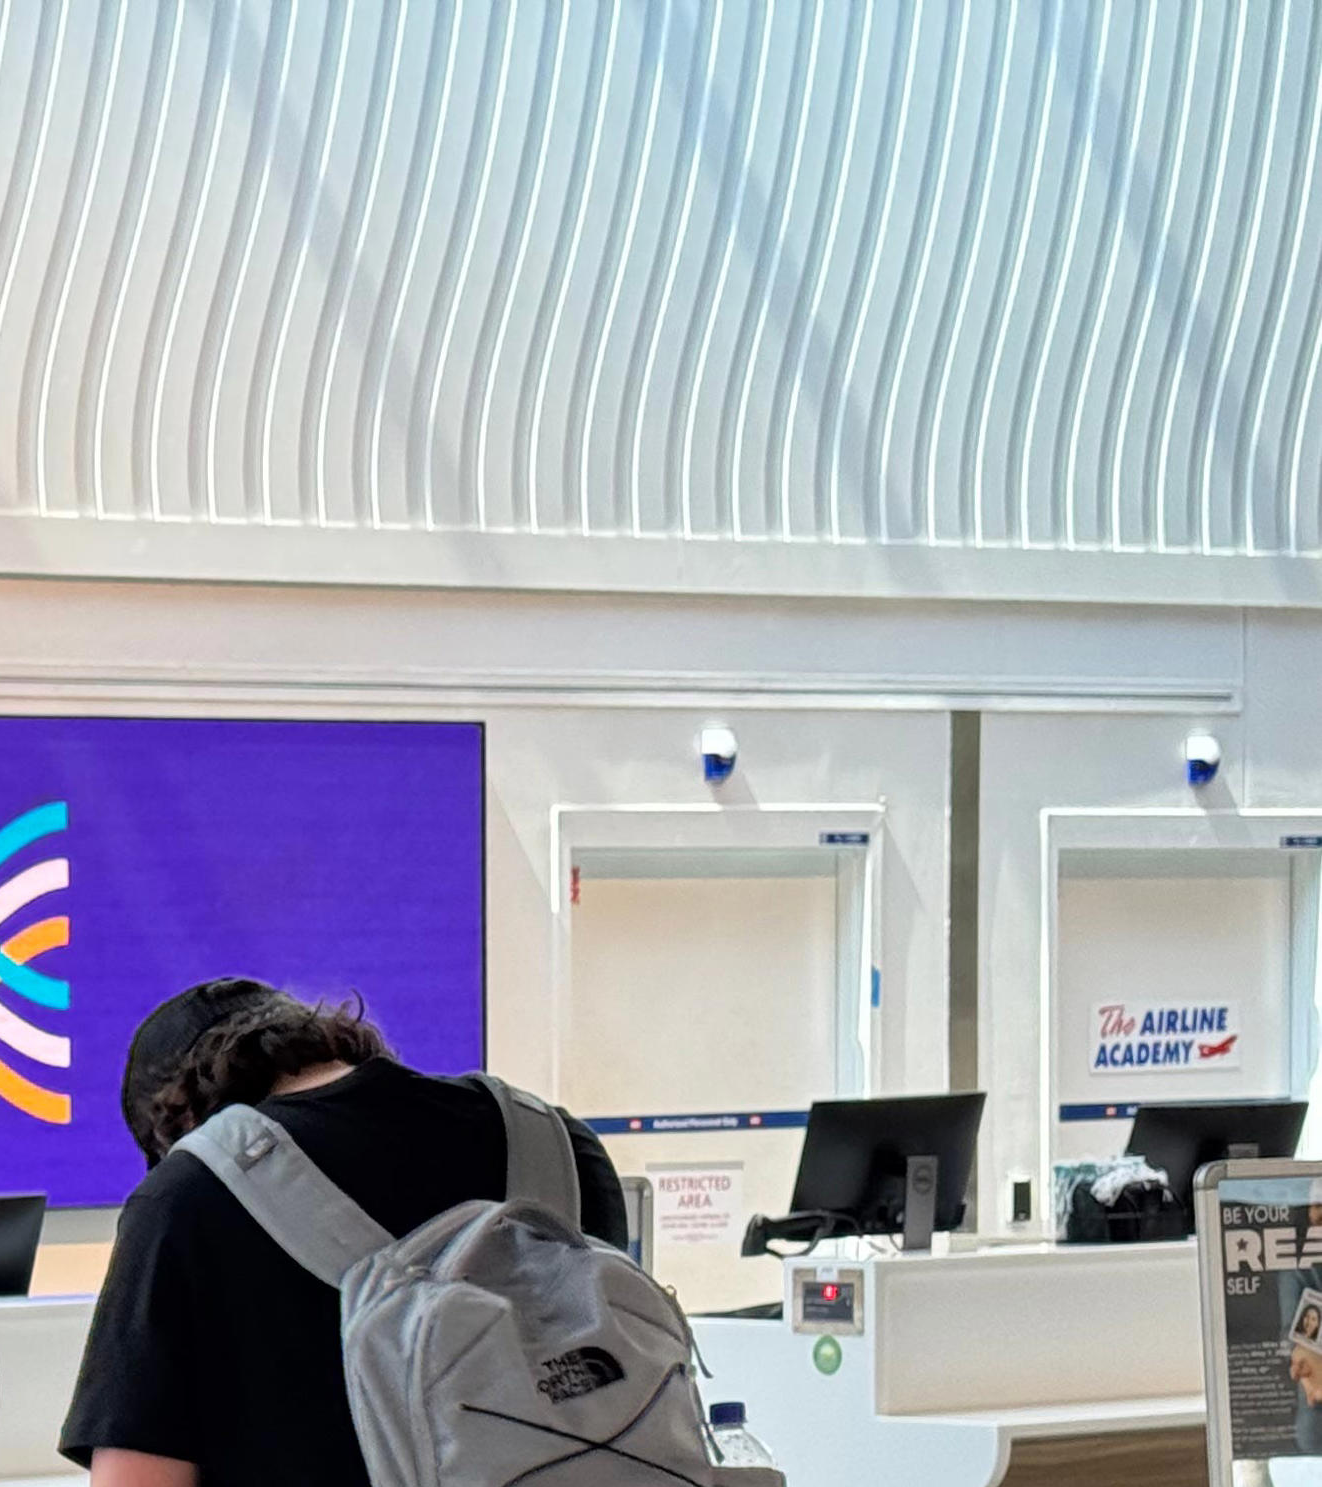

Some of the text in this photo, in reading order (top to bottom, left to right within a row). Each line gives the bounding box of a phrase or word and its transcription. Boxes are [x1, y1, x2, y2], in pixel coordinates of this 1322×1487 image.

[1098, 1004, 1228, 1038] The AIRLINE
[1094, 1040, 1194, 1068] ACADEMY
[659, 1176, 731, 1192] RESTRICTED
[678, 1193, 712, 1208] AREA
[1223, 1205, 1289, 1225] BE YOUR
[1226, 1276, 1261, 1295] SELF
